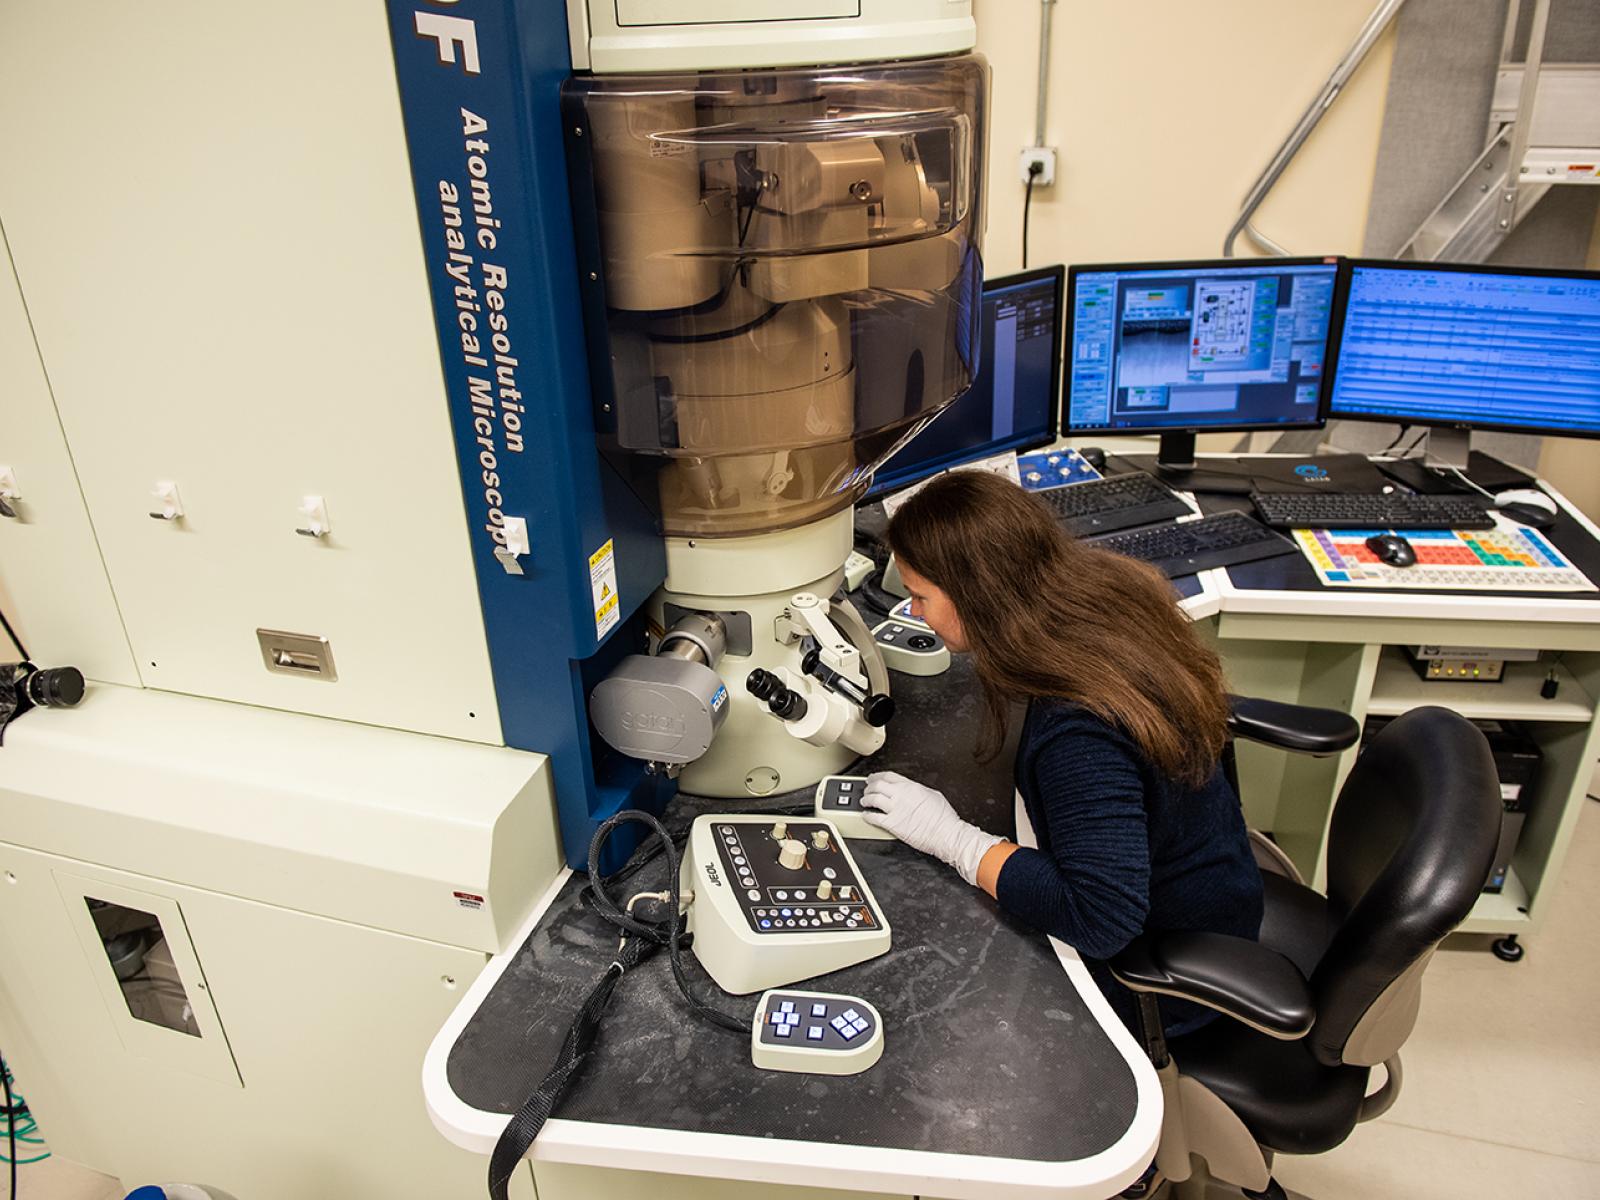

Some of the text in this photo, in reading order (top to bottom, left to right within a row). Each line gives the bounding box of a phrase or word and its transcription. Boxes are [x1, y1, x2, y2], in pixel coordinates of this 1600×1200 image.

[414, 0, 481, 74] F
[438, 179, 488, 367] analytical
[460, 106, 526, 453] Atomic Resolution
[705, 861, 722, 887] JEOL
